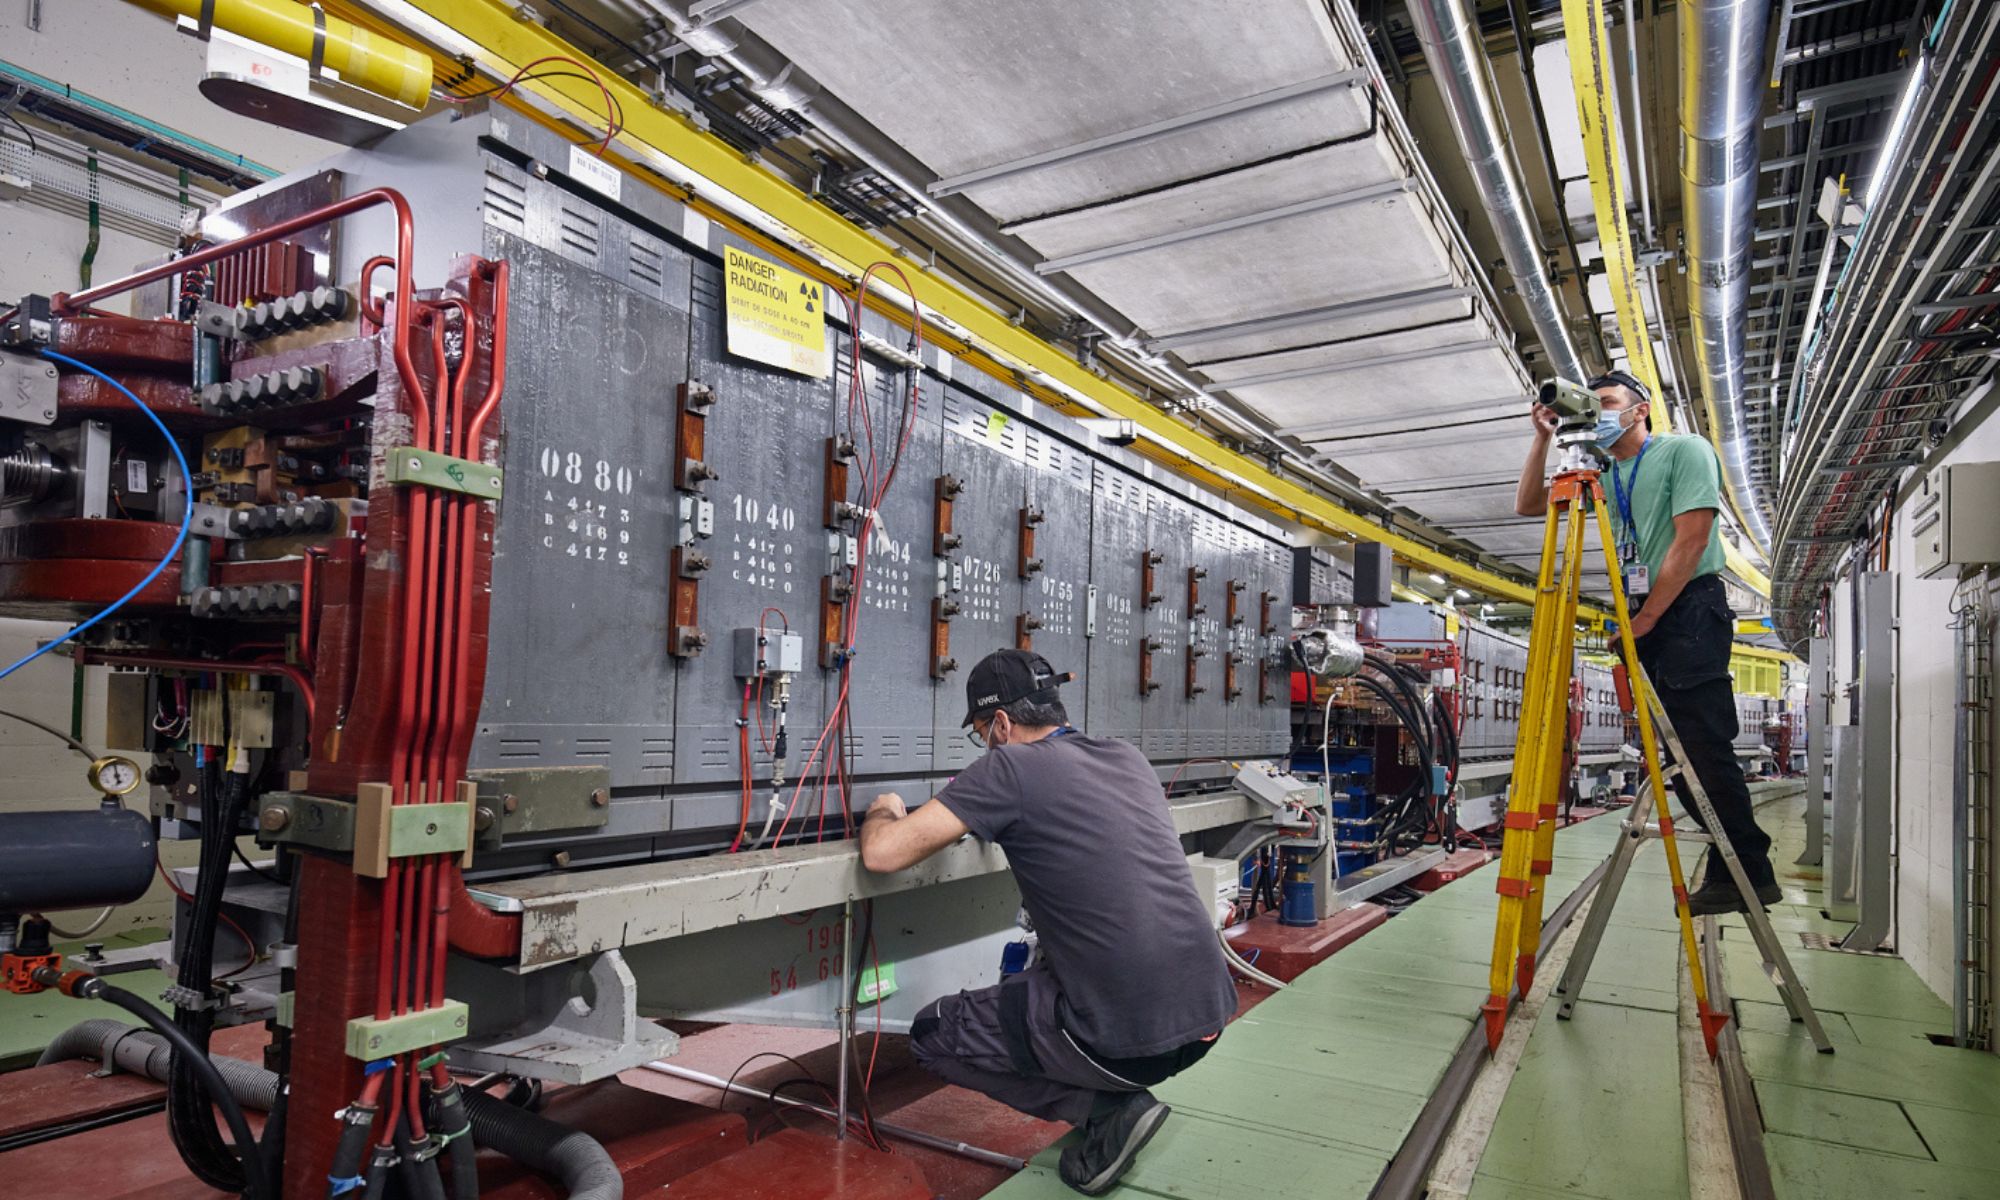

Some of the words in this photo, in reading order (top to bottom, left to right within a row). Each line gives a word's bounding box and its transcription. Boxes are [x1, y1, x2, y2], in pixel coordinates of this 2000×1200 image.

[730, 271, 788, 304] RADIATION
[544, 490, 553, 502] A
[544, 512, 554, 526] B
[543, 535, 553, 548] C
[733, 533, 741, 543] A
